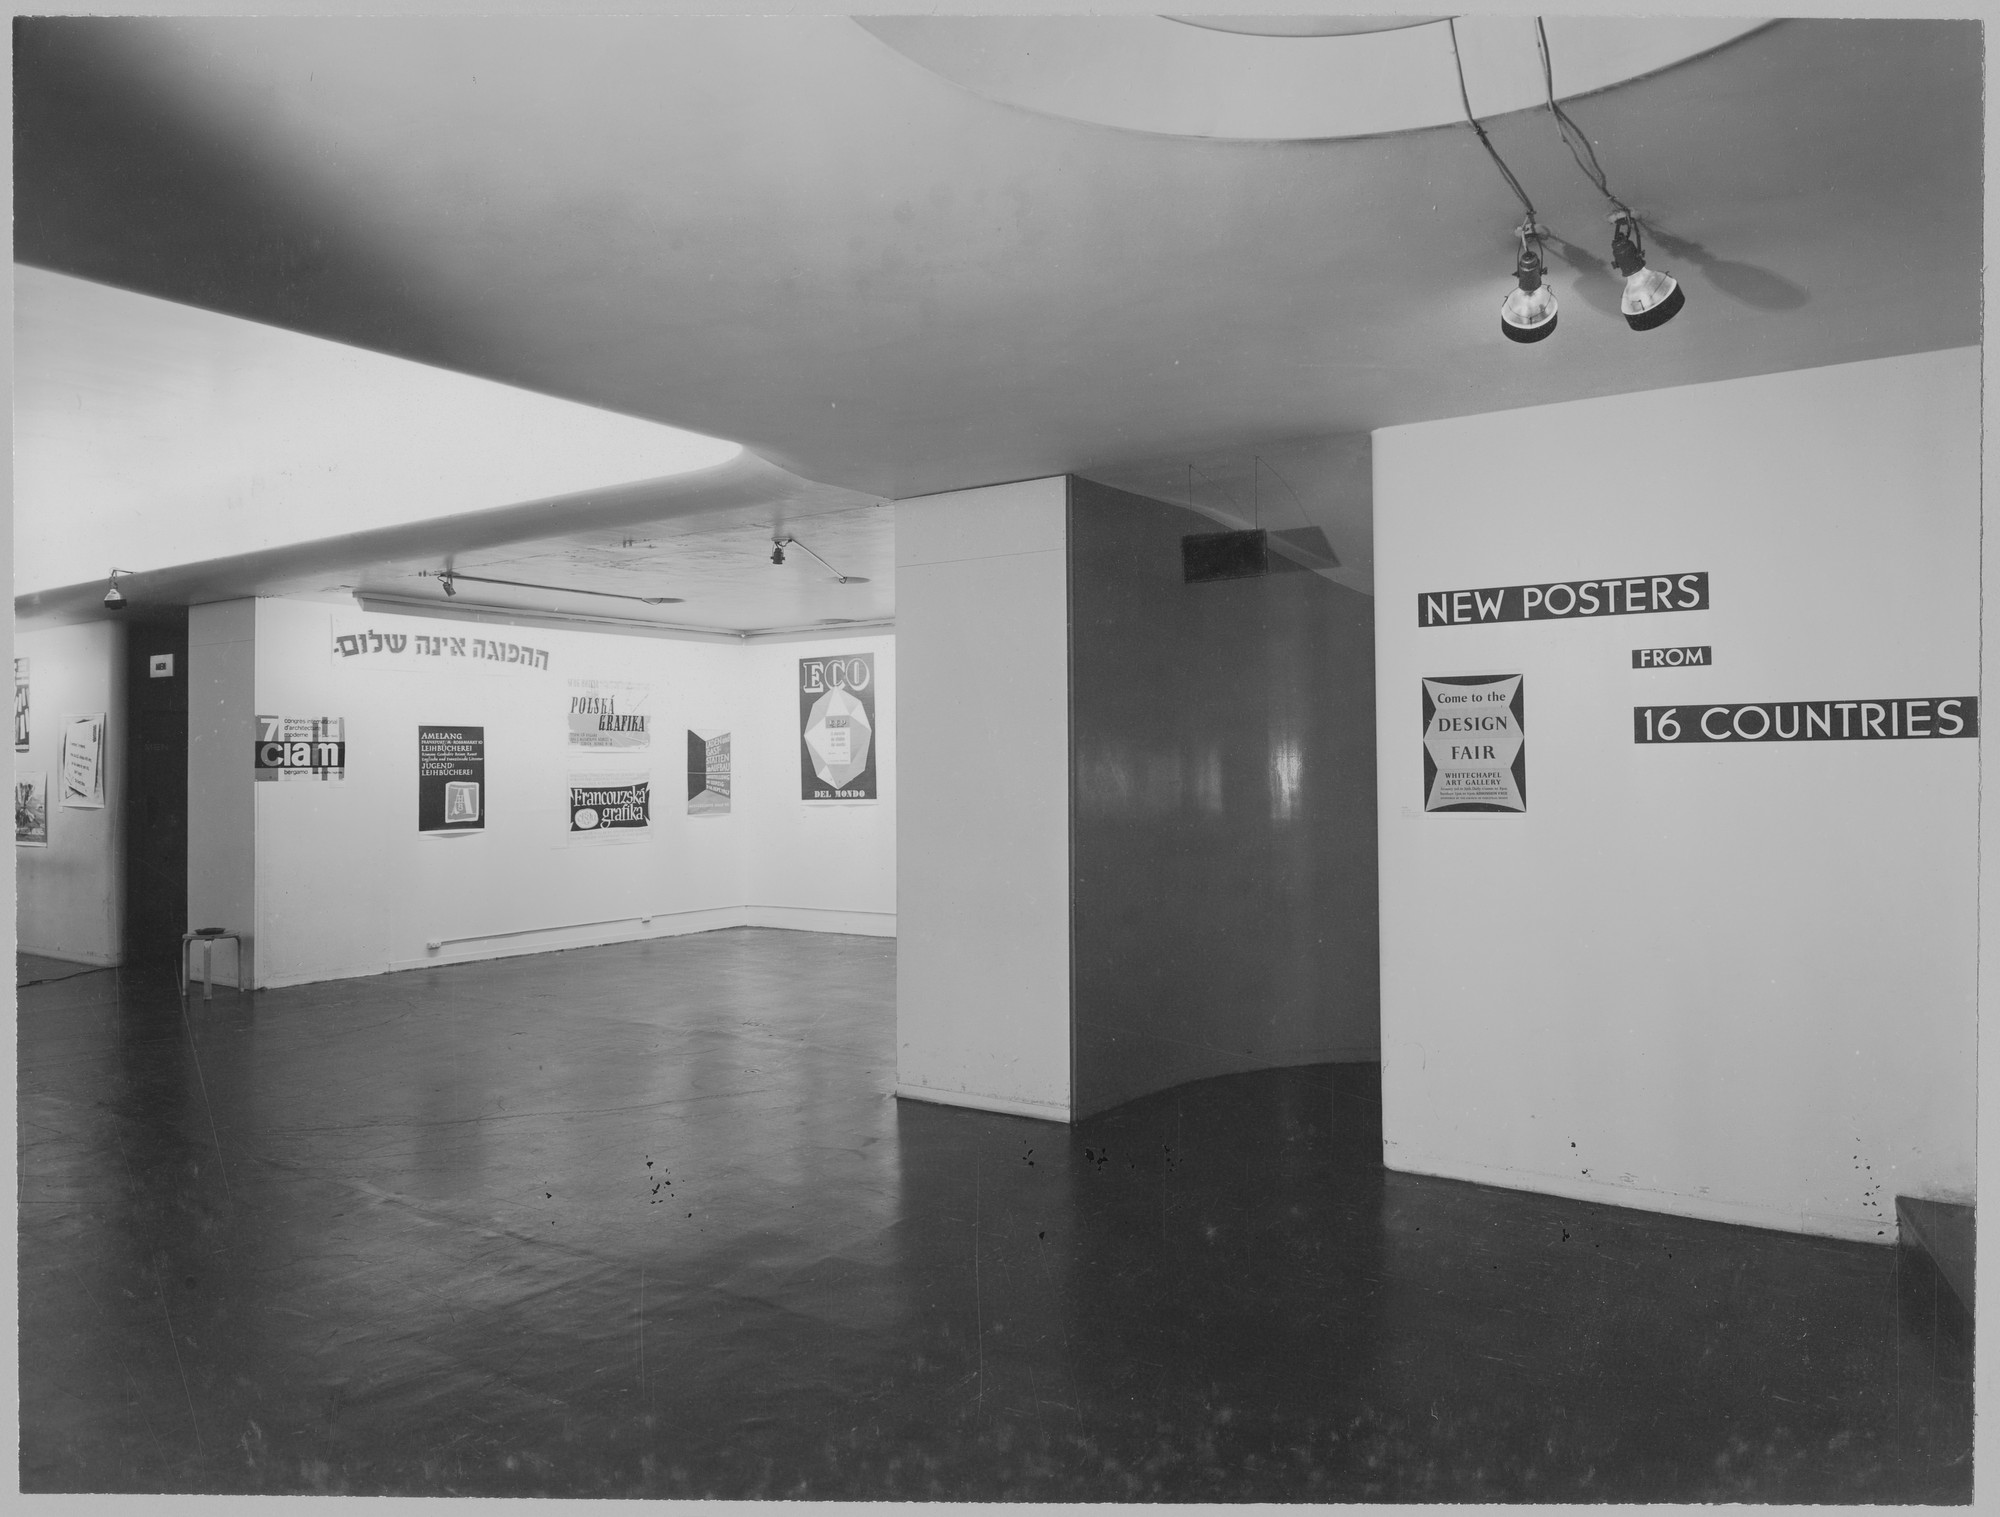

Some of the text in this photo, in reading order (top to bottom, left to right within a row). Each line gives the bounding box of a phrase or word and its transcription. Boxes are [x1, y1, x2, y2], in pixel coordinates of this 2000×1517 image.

[1426, 575, 1700, 625] NEW POSTERS
[333, 629, 549, 671] ההפוגה אינה שלום.
[1640, 647, 1704, 668] FROM
[803, 658, 870, 693] ECO
[570, 695, 615, 715] POLSKÁ
[1437, 691, 1506, 704] Come to the
[260, 717, 279, 742] 7
[598, 715, 645, 732] GRAFIKA
[1438, 716, 1508, 732] DESIGN
[1643, 699, 1965, 741] 16 COUNTRIES
[421, 732, 463, 740] AMELANG
[1451, 745, 1496, 760] FAIR
[573, 785, 646, 808] Francouzská
[814, 789, 866, 798] DEL MONDO
[600, 803, 644, 829] grafika
